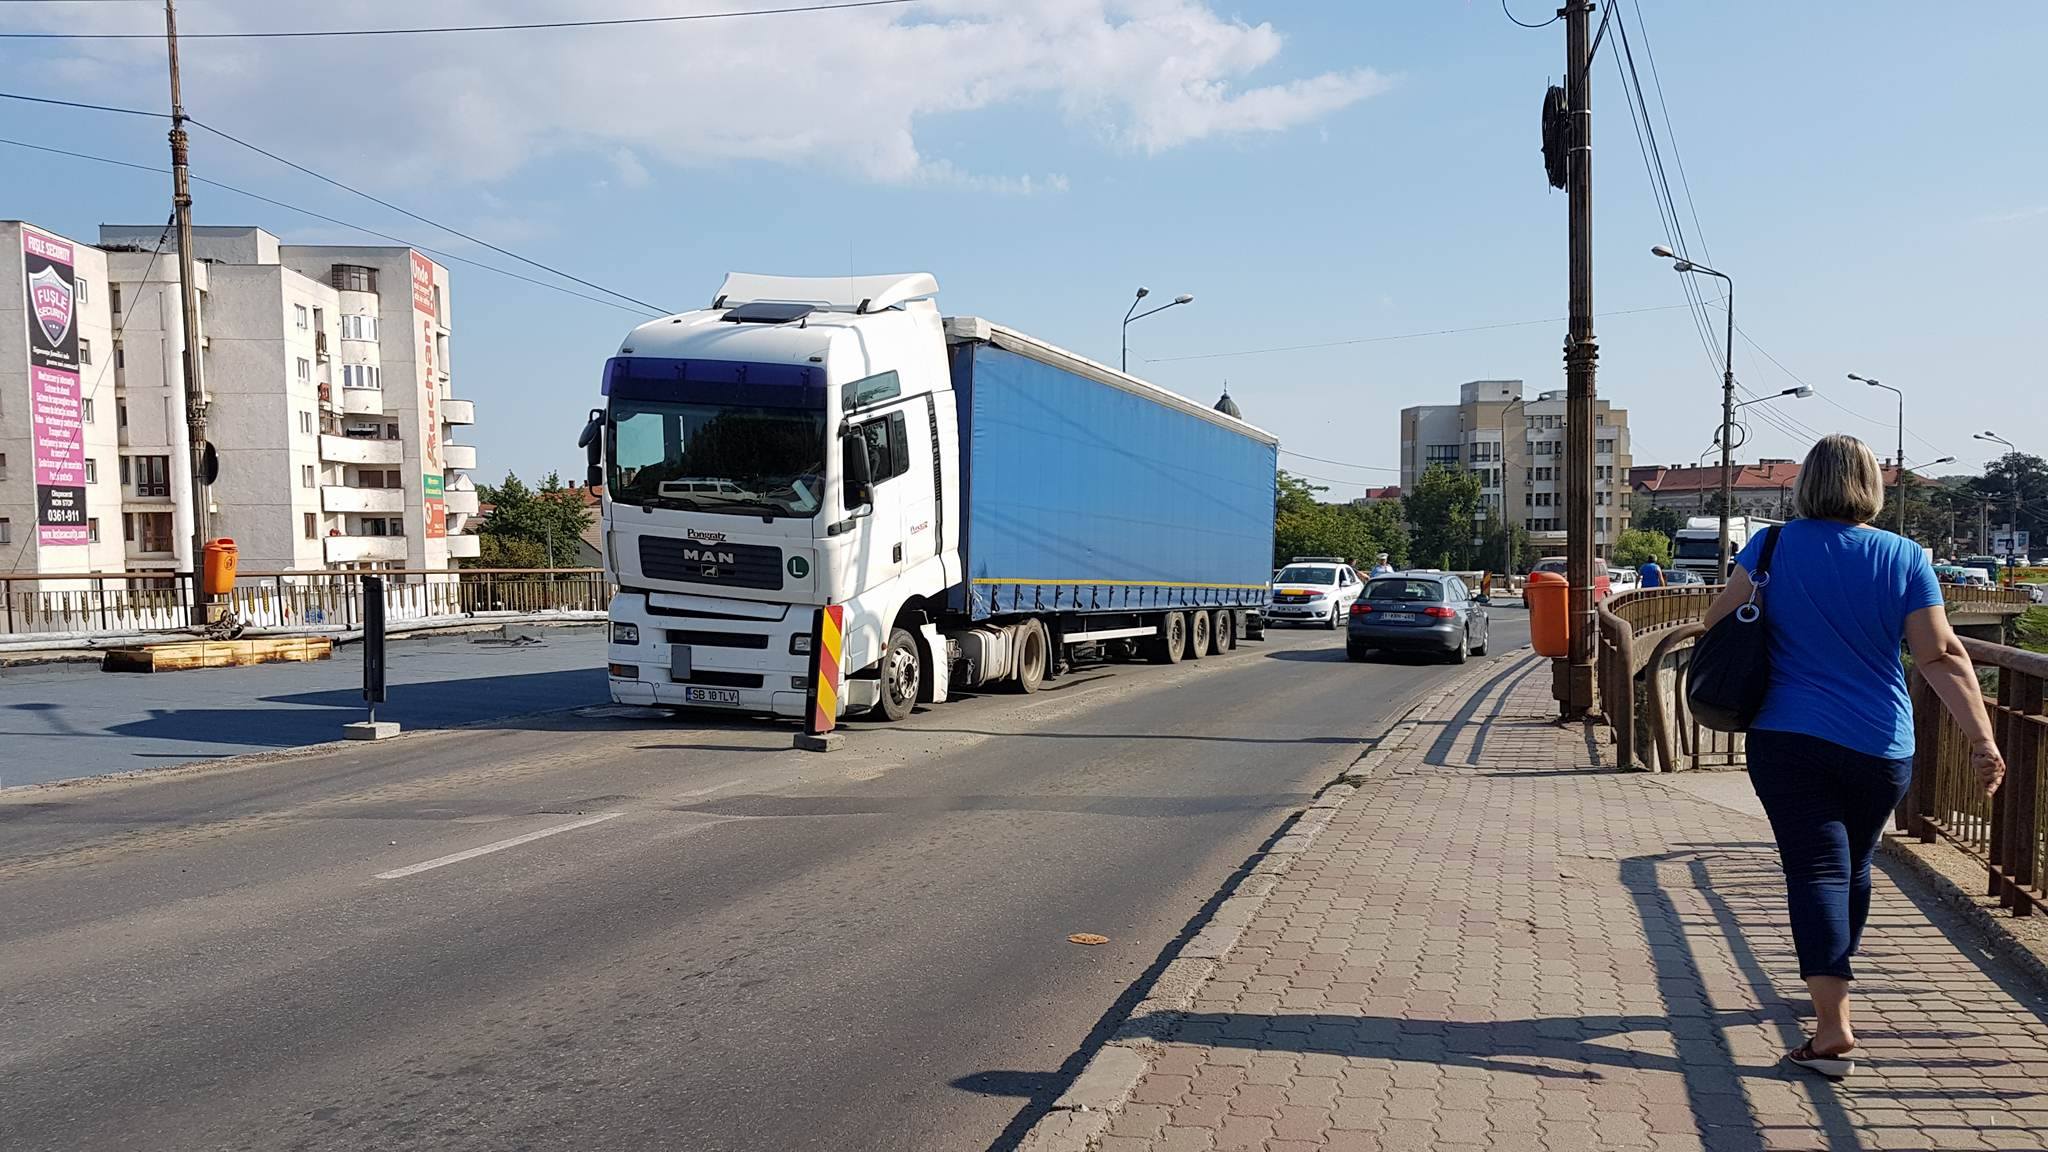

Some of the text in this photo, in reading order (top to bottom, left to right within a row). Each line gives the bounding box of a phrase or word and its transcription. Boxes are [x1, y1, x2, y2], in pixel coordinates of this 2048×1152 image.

[46, 241, 70, 262] SECURITY
[38, 306, 68, 324] SECURITY
[62, 499, 74, 507] STOP
[47, 509, 80, 522] 0361-911
[687, 528, 727, 542] Pongratz
[684, 549, 734, 564] MAN
[792, 560, 804, 576] L
[692, 689, 706, 700] SB
[718, 691, 736, 702] TLV
